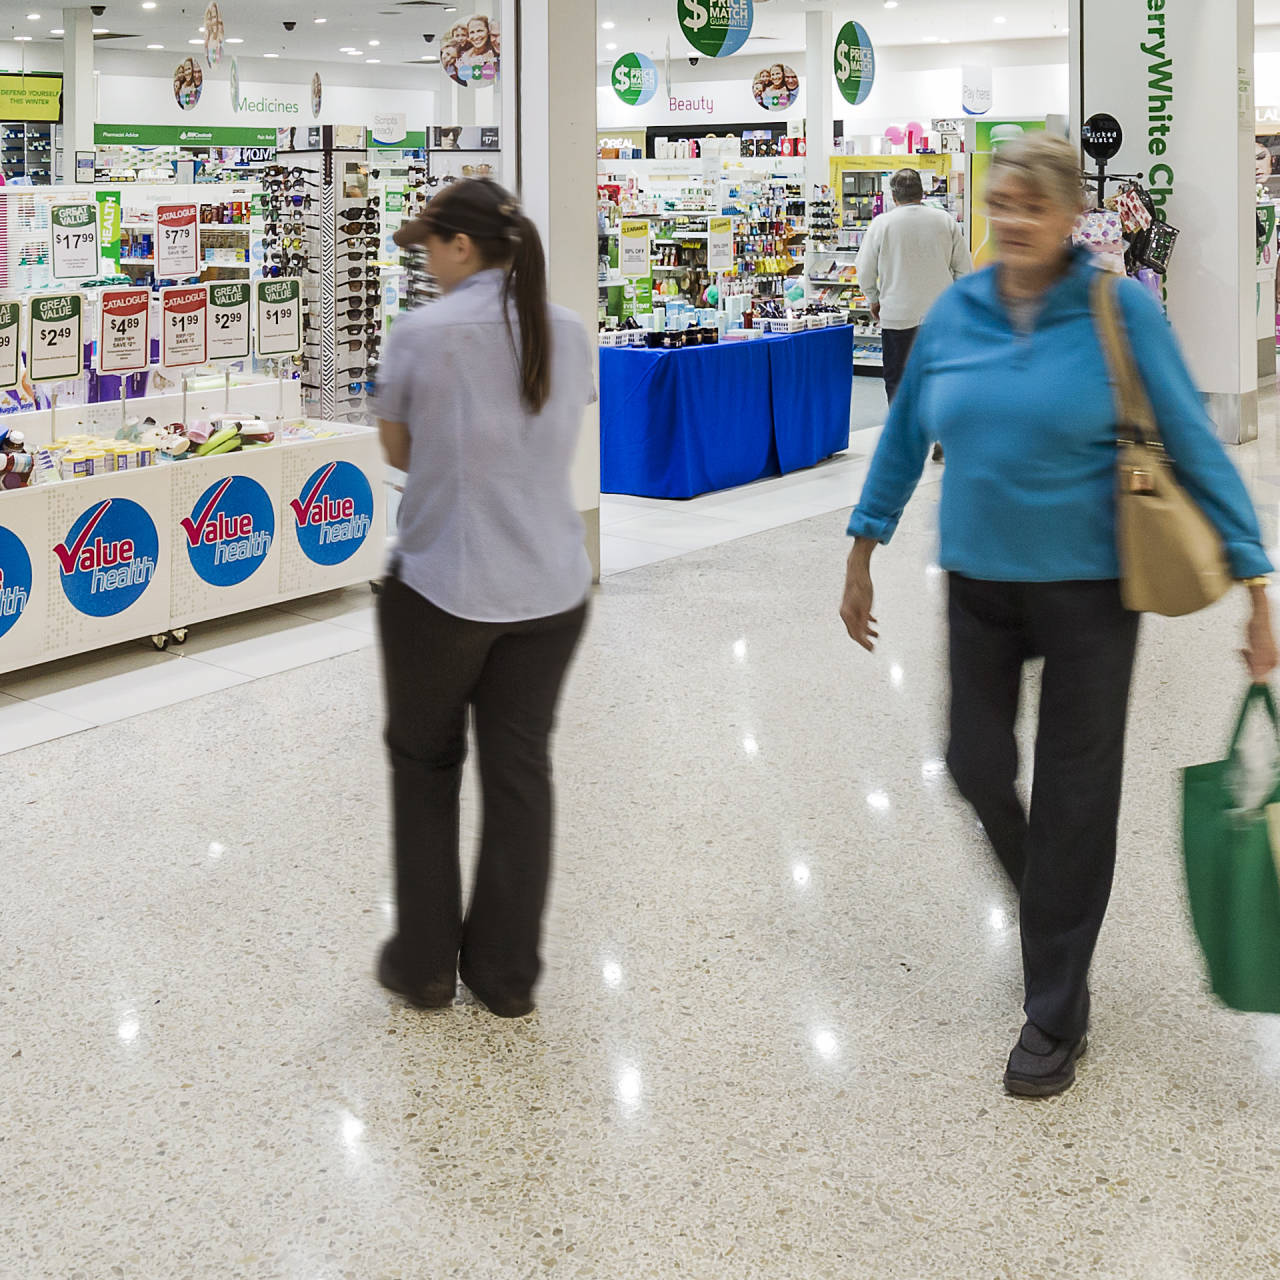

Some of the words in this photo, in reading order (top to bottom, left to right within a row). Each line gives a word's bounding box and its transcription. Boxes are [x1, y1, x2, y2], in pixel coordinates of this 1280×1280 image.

[709, 7, 748, 19] MATCH
[710, 18, 748, 26] GUARANTEE
[850, 48, 872, 61] PRICE
[238, 96, 299, 114] Medicines
[669, 96, 714, 113] Beauty
[58, 205, 88, 217] GREAT
[157, 207, 196, 221] CATALOGUE
[59, 212, 89, 225] VALUE
[102, 196, 116, 247] HEALTH
[621, 224, 648, 234] CLEARANCE
[214, 284, 242, 297] GREAT
[264, 281, 291, 294] GREAT
[103, 293, 148, 310] CATALOGUE
[163, 292, 207, 308] CATALOGUE
[215, 292, 243, 305] VALUE
[265, 289, 292, 301] VALUE
[40, 296, 72, 311] GREAT
[40, 306, 72, 320] VALUE
[290, 462, 353, 527] Value
[180, 476, 253, 547] Value
[319, 514, 370, 545] health
[53, 499, 134, 575] Value
[214, 531, 271, 565] health
[91, 557, 154, 594] health
